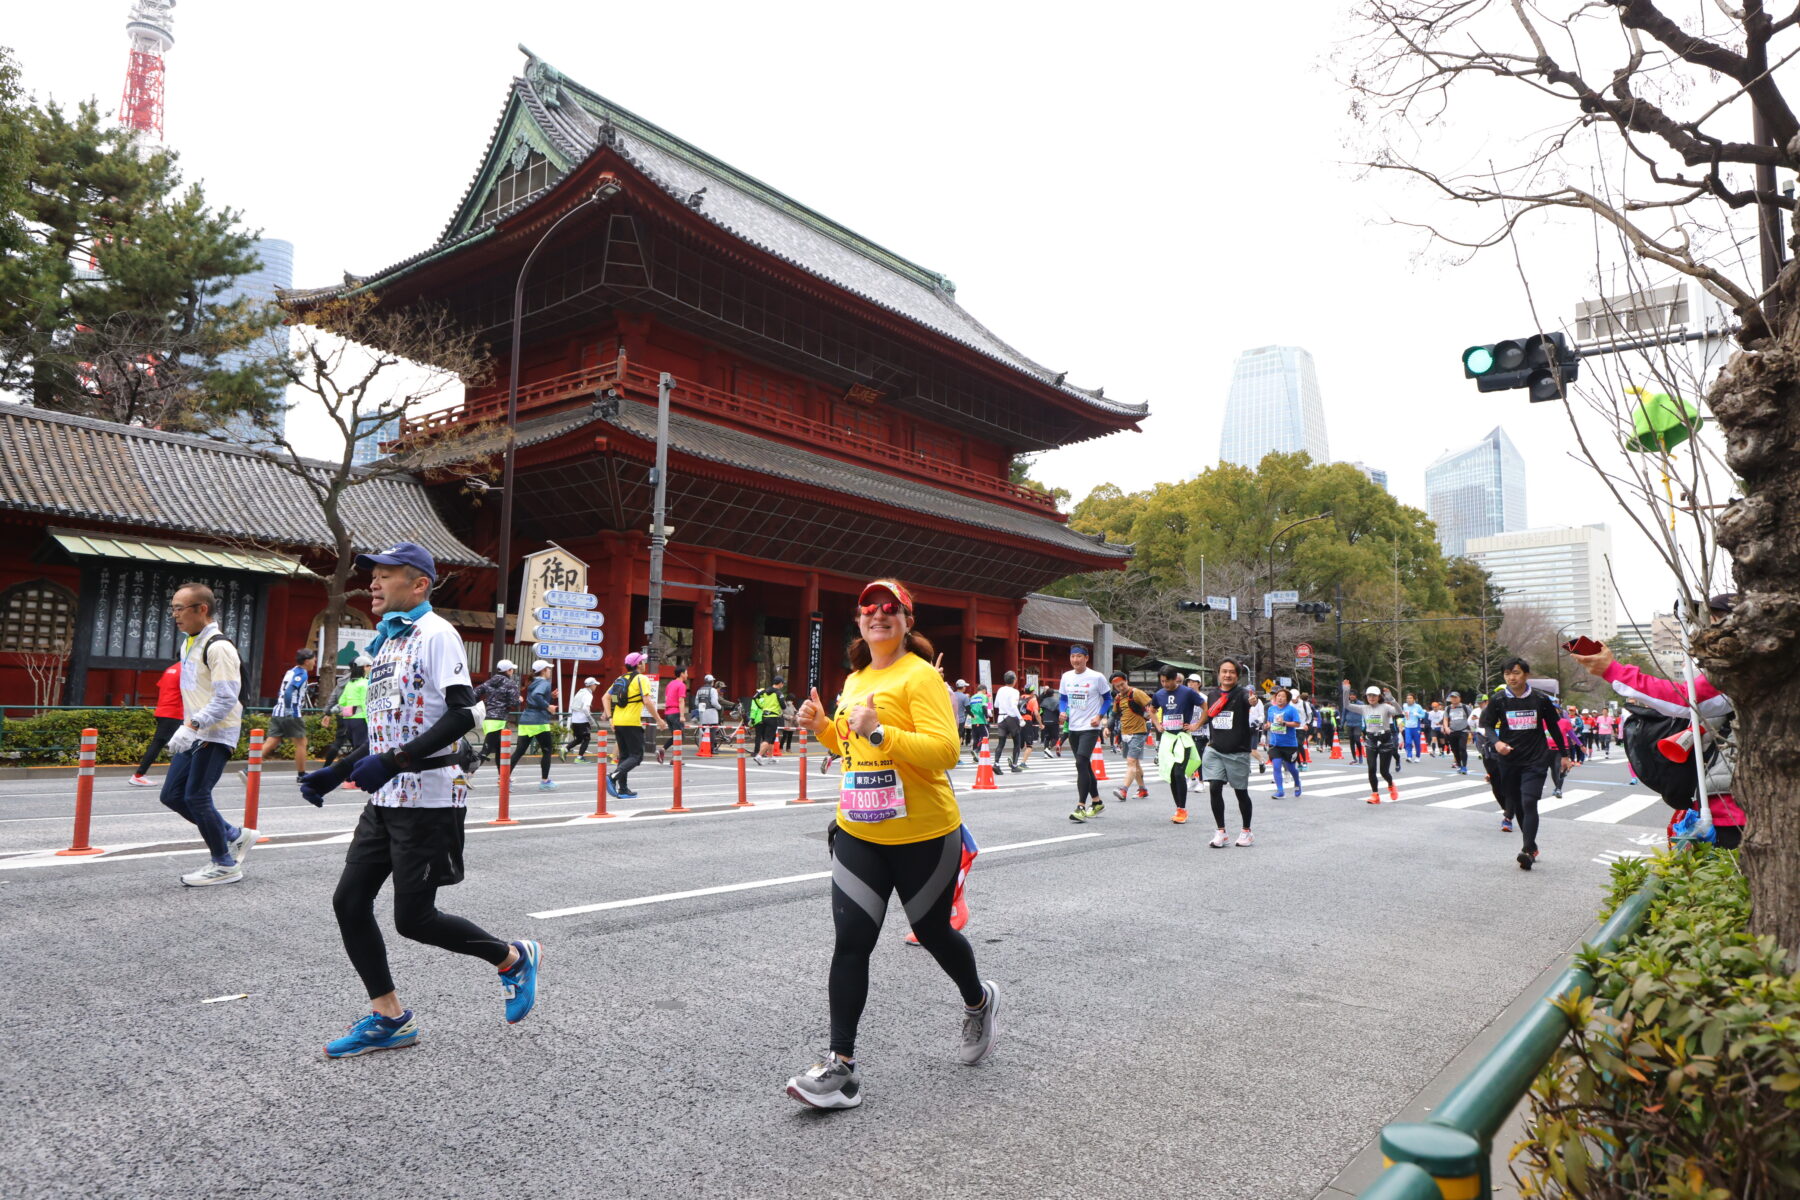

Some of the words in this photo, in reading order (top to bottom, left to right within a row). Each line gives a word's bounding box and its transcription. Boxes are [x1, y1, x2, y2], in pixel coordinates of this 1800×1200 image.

[856, 774, 893, 785] 東京メトロ
[850, 790, 889, 809] 78003
